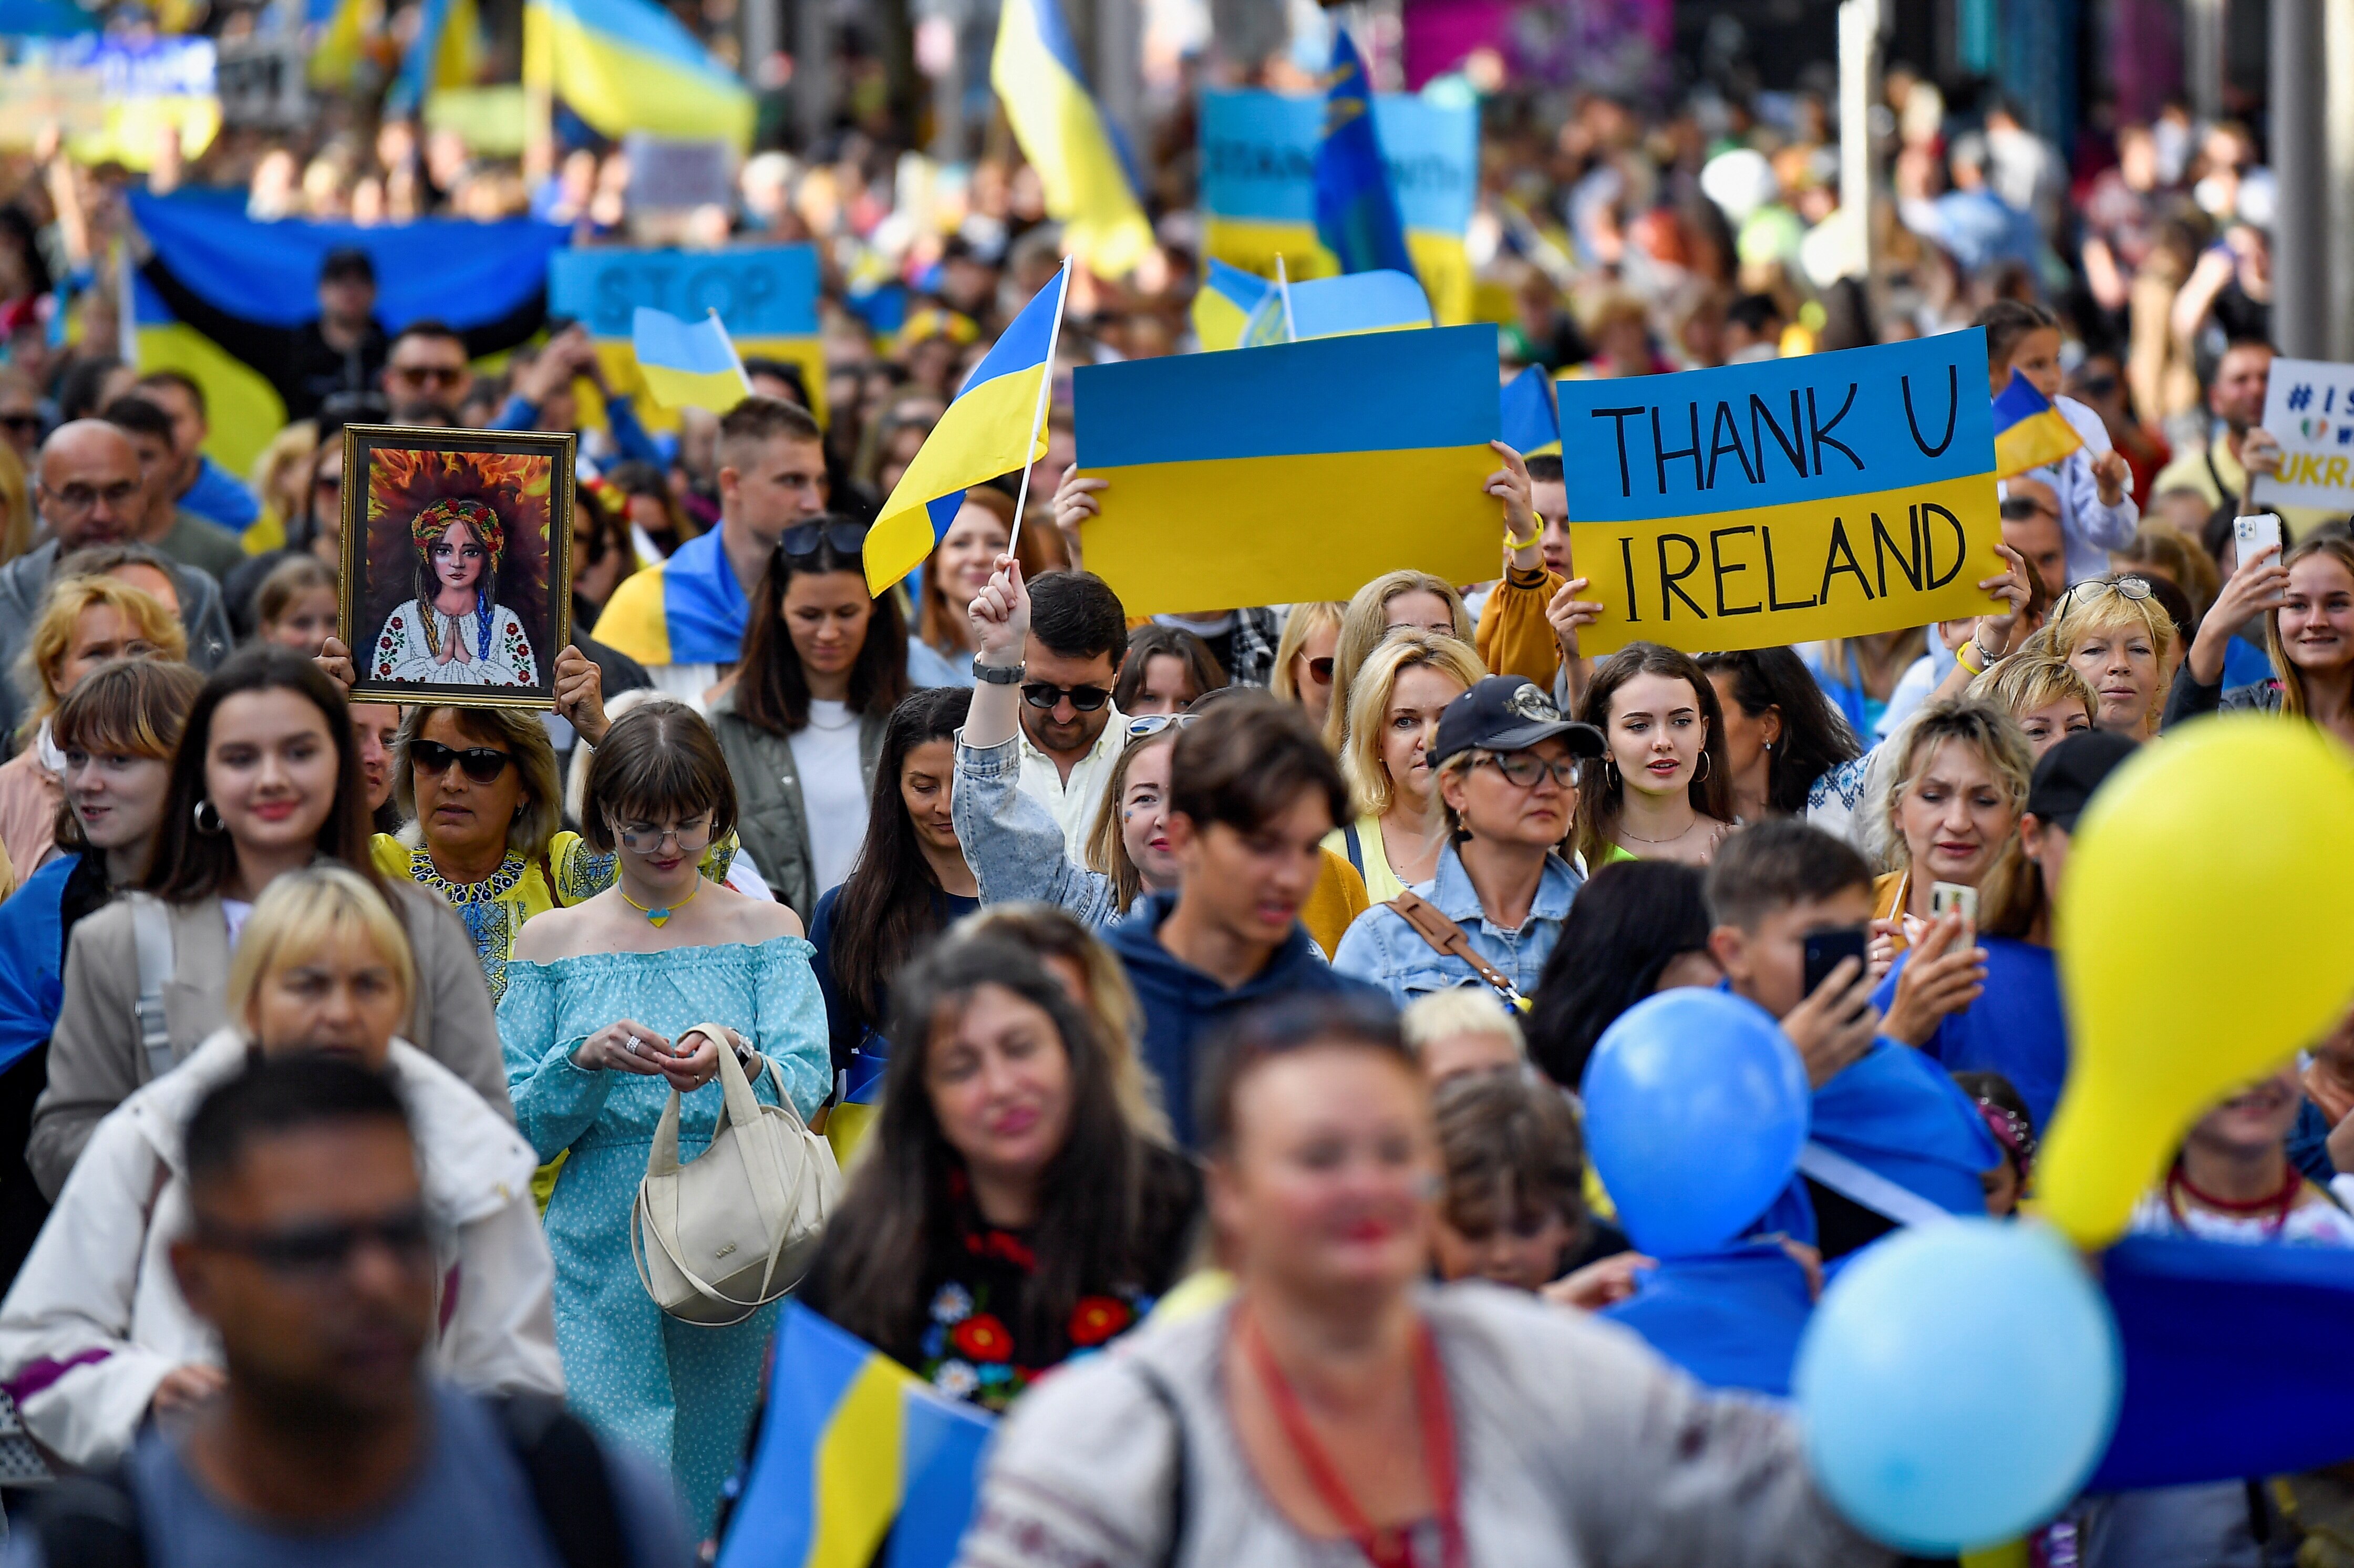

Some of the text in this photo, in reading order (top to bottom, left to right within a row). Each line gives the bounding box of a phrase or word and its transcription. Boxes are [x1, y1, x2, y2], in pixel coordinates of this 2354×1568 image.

[596, 265, 779, 328] STOP
[1591, 364, 1958, 497] THANK U
[2273, 450, 2354, 490] UKR
[1618, 502, 1966, 623] IRELAND
